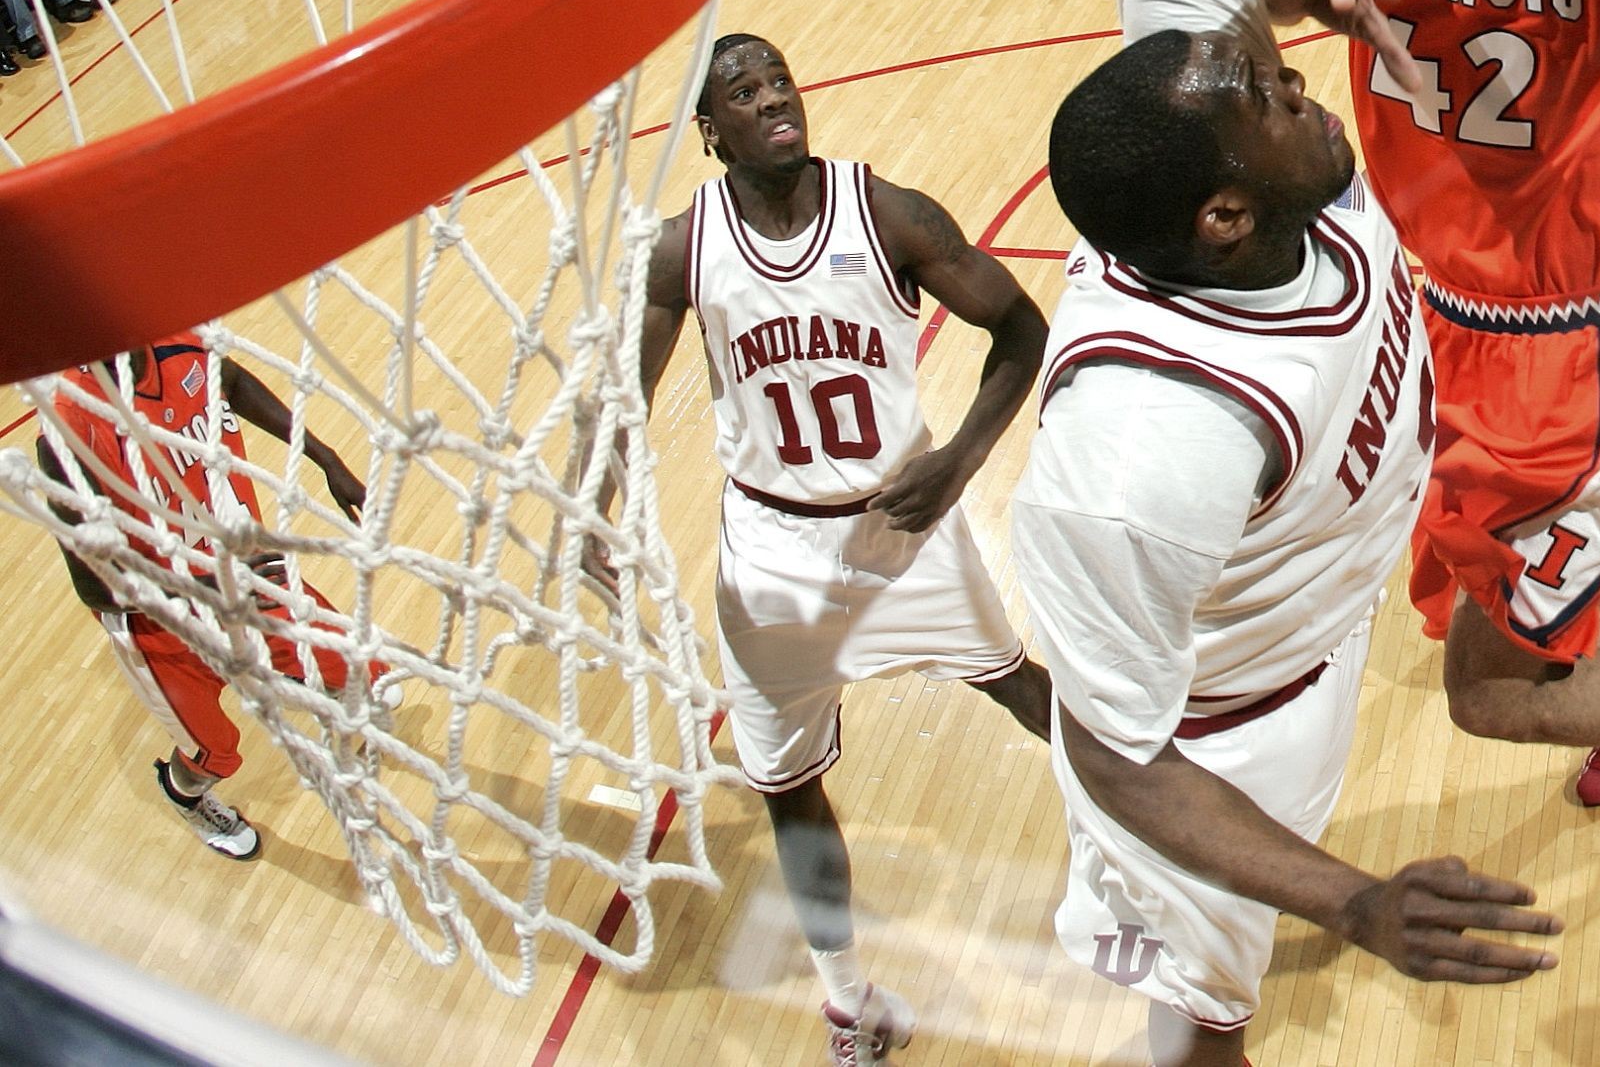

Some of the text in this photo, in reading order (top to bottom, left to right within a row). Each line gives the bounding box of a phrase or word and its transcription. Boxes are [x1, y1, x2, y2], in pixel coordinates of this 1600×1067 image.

[1370, 17, 1536, 149] 42
[729, 314, 888, 384] INDIANA
[763, 373, 882, 465] 10
[1526, 521, 1590, 590] I
